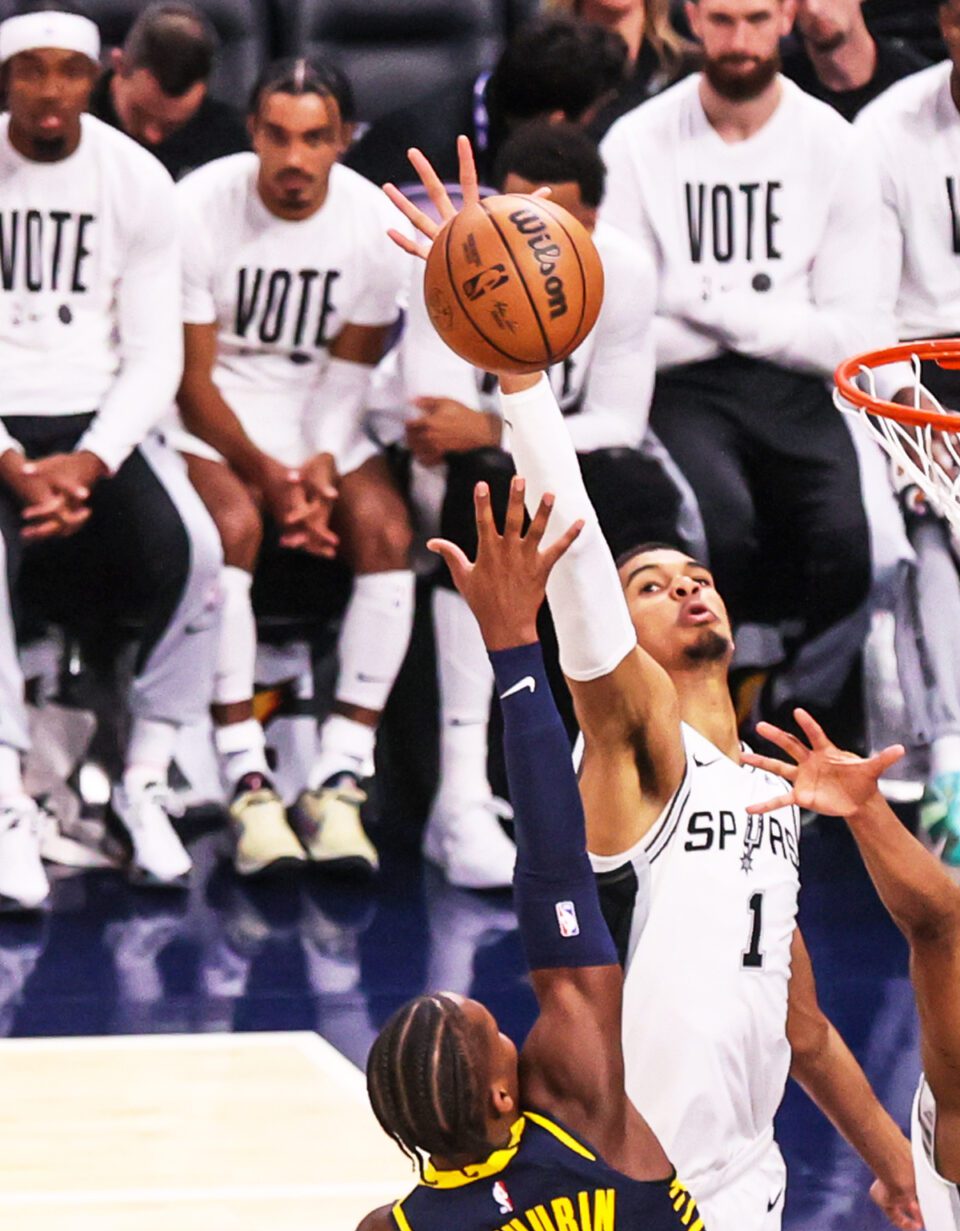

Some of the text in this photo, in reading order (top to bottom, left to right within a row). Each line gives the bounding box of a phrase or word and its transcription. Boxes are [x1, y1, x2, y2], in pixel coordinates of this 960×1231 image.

[0, 209, 96, 292] VOTE
[685, 181, 783, 263] VOTE
[508, 208, 568, 320] Wilson
[234, 266, 341, 347] VOTE
[684, 810, 800, 874] SPURS
[741, 890, 765, 970] 1
